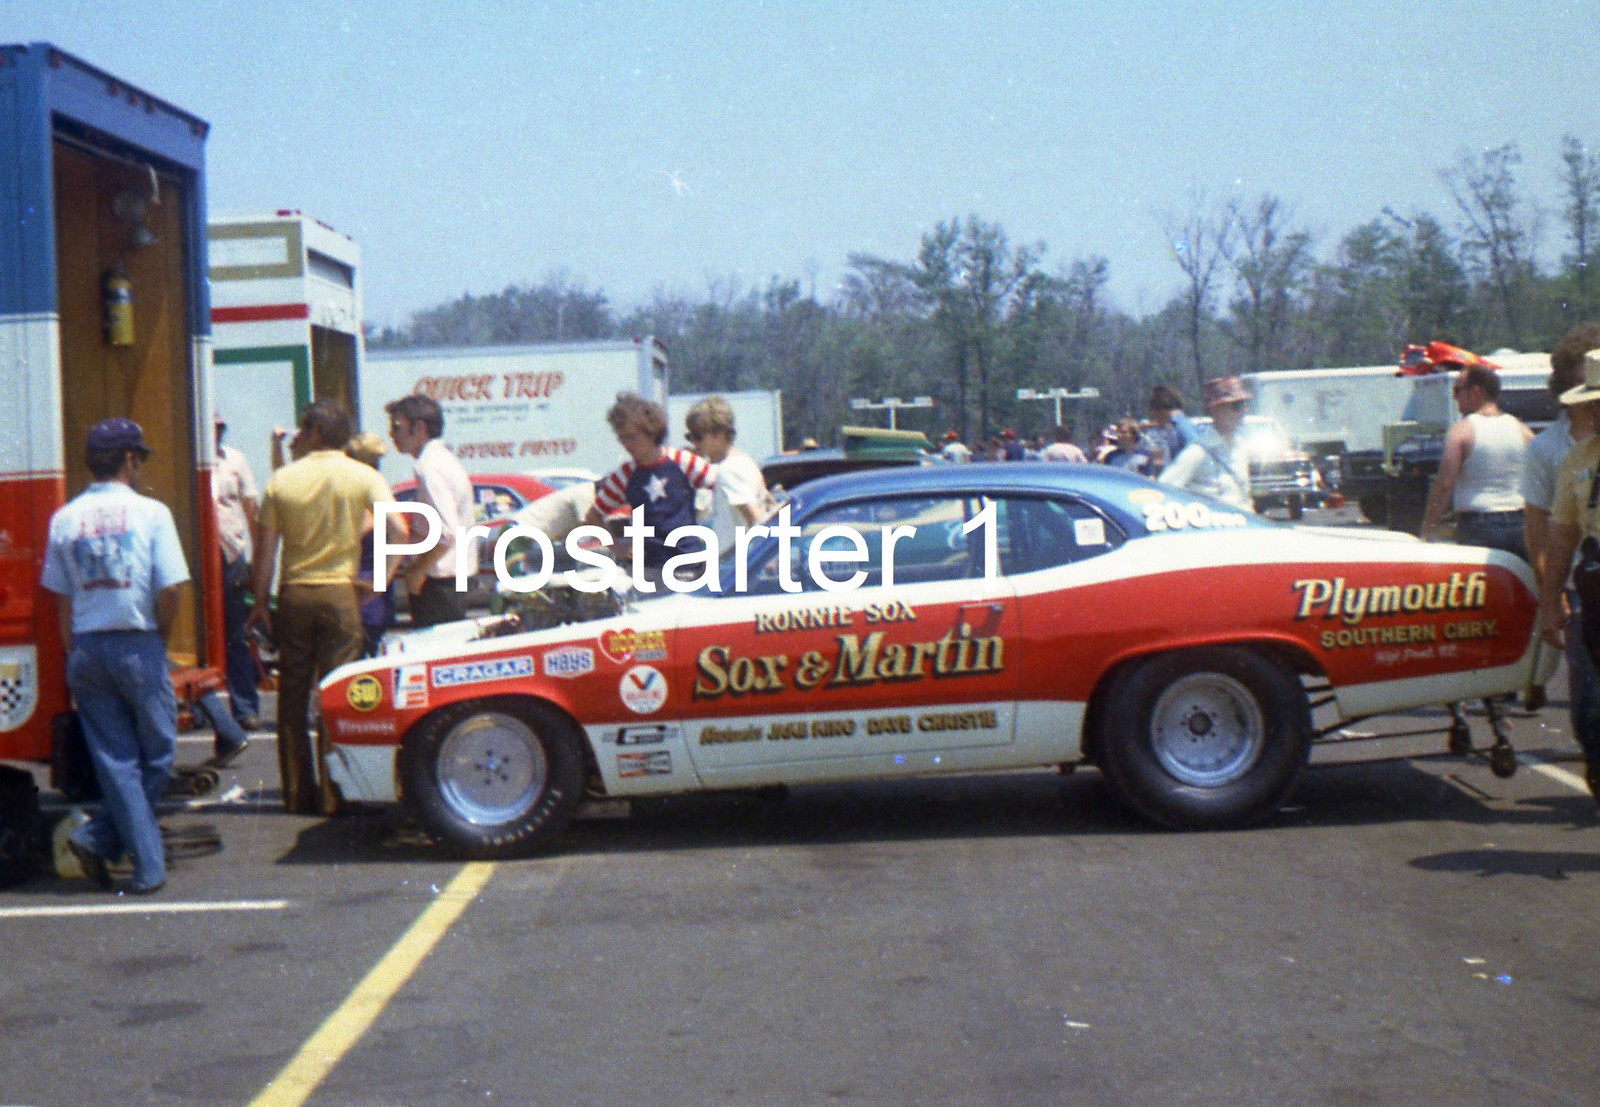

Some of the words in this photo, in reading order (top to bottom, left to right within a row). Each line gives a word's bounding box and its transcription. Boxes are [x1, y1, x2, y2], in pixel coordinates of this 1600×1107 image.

[413, 374, 496, 401] QUICK
[502, 371, 565, 398] TRIP
[1143, 502, 1210, 532] 200
[1292, 571, 1488, 624] Plymouth
[755, 605, 853, 633] RONNIE
[865, 600, 917, 623] SOX
[1320, 625, 1436, 649] SOUTHERN
[433, 659, 532, 686] CRAGAR
[693, 644, 789, 701] Sox
[792, 650, 832, 690] &
[829, 628, 1005, 688] Martin
